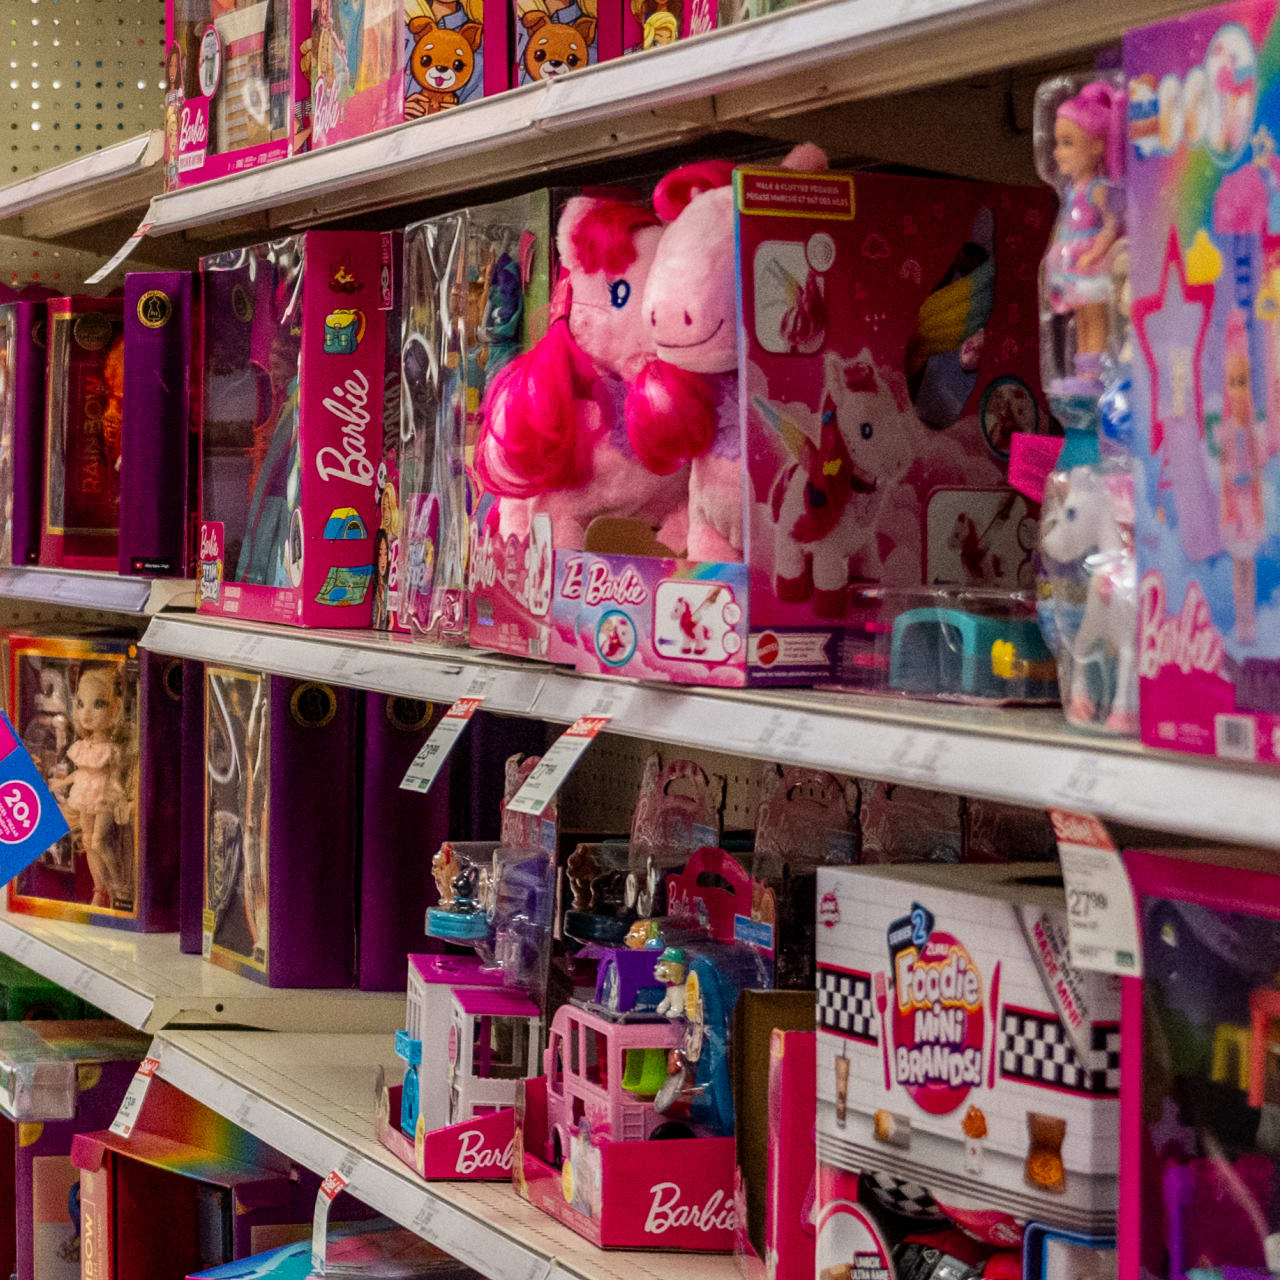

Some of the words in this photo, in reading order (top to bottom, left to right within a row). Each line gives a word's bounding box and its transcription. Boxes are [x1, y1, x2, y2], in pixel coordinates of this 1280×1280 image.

[179, 100, 208, 150] Barbie
[315, 368, 376, 489] Barbie
[582, 559, 649, 607] Barbie
[3, 788, 31, 829] 20+
[910, 908, 928, 947] 2
[897, 952, 981, 1007] Foodie
[895, 1044, 984, 1089] BRANDS!
[645, 1181, 742, 1234] Barbie
[854, 1253, 882, 1268] UNBOX
